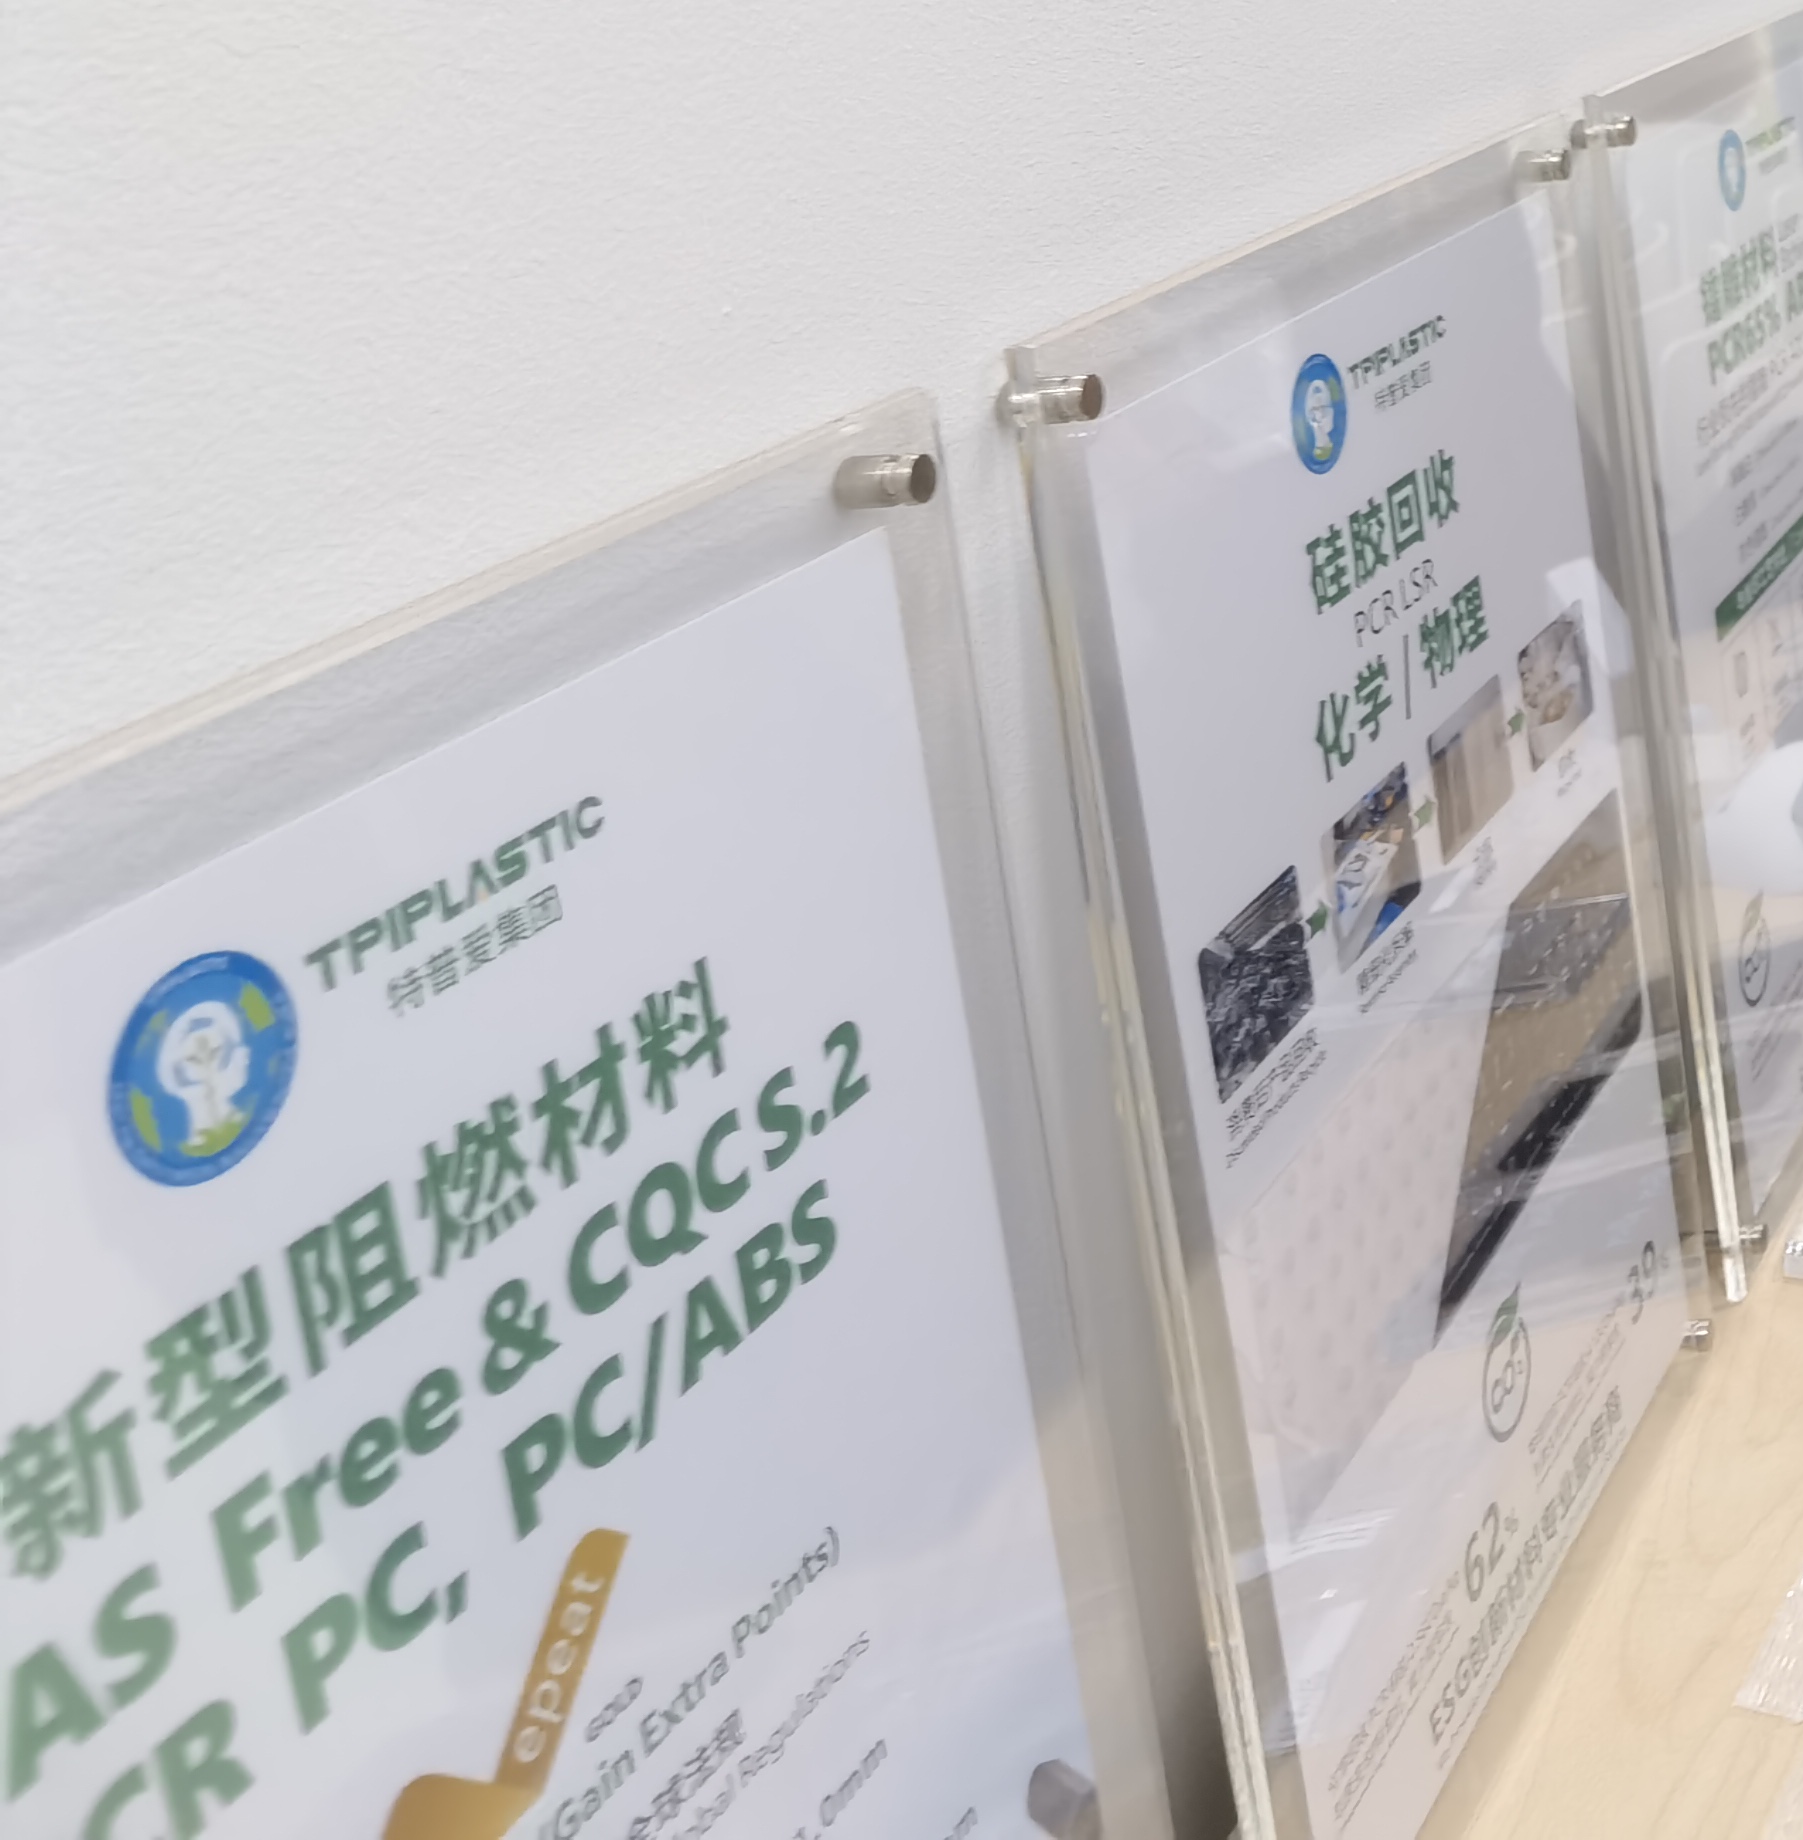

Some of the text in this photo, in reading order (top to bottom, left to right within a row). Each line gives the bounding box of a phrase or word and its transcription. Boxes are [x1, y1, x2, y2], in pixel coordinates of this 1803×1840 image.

[1305, 449, 1460, 615] 硅胶回收
[1353, 559, 1439, 648] PCR LSR
[1315, 574, 1489, 782] 化学 物理
[304, 795, 607, 992] TPIPLASTIC
[0, 957, 730, 1580] 新型阻燃材料
[7, 1560, 178, 1803] AS
[208, 1366, 464, 1614] Free
[481, 1277, 560, 1395] &
[278, 1522, 470, 1735] PC,
[498, 1179, 837, 1543] PC/ABS
[513, 1571, 604, 1763] epeat
[640, 1651, 728, 1758] Extra
[731, 1526, 840, 1658] Points)
